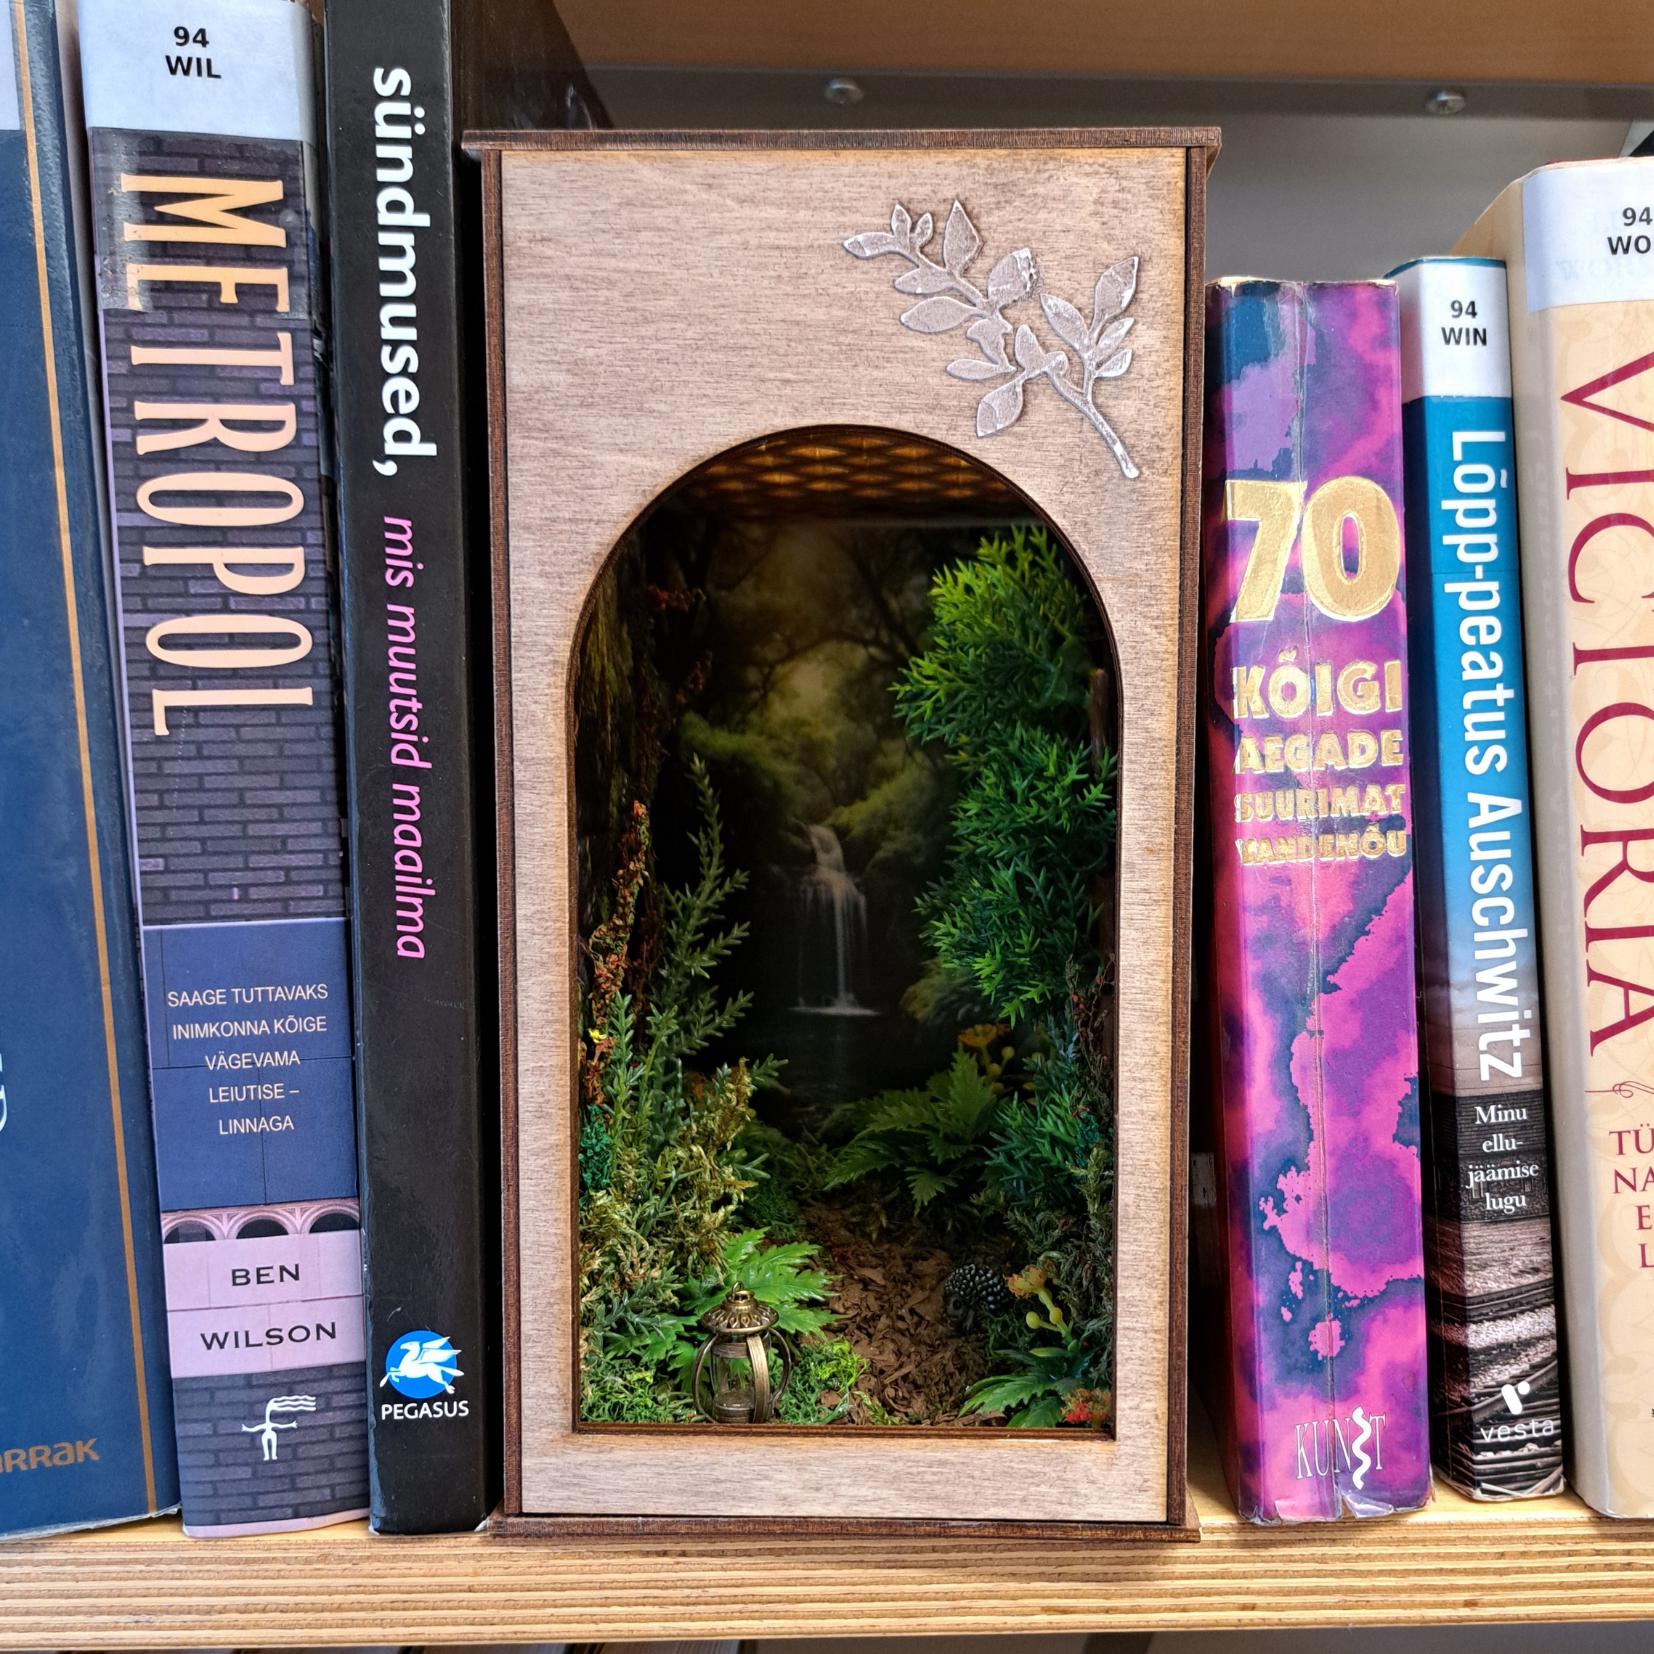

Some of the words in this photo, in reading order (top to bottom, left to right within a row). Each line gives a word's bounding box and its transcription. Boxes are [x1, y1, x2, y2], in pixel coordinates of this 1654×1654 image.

[173, 26, 210, 48] 94
[165, 55, 222, 79] WIL
[1622, 206, 1654, 227] 94
[372, 66, 438, 477] sündmused,
[1450, 299, 1479, 319] 94
[1441, 326, 1488, 346] WIN
[120, 172, 314, 737] METROPOL
[383, 515, 426, 589] mis
[1225, 475, 1401, 623] 70
[1440, 430, 1515, 775] Lõpp-peatus
[386, 603, 433, 769] muutsid
[1232, 645, 1403, 719] KÕIGI
[1234, 729, 1404, 774] AEGADE
[1234, 783, 1407, 823] SUURIMAT
[391, 782, 437, 960] maailma
[1466, 791, 1532, 1081] Auschwitz
[167, 988, 228, 1008] SAAGE
[231, 983, 329, 1004] TUTTAVAKS
[172, 1020, 271, 1040] INIMKONNA
[274, 1015, 328, 1034] KÕIGE
[204, 1050, 301, 1071] VÄGEVAMA
[208, 1083, 286, 1103] LEIUTISE
[218, 1115, 295, 1135] LINNAGA
[1474, 1104, 1528, 1124] Minu
[1482, 1133, 1524, 1153] ellu-
[1465, 1160, 1540, 1189] jäämise
[1484, 1192, 1527, 1214] lugu
[230, 1262, 302, 1287] BEN
[200, 1320, 338, 1351] WILSON
[380, 1399, 470, 1421] PEGASUS
[1480, 1418, 1555, 1443] vesta
